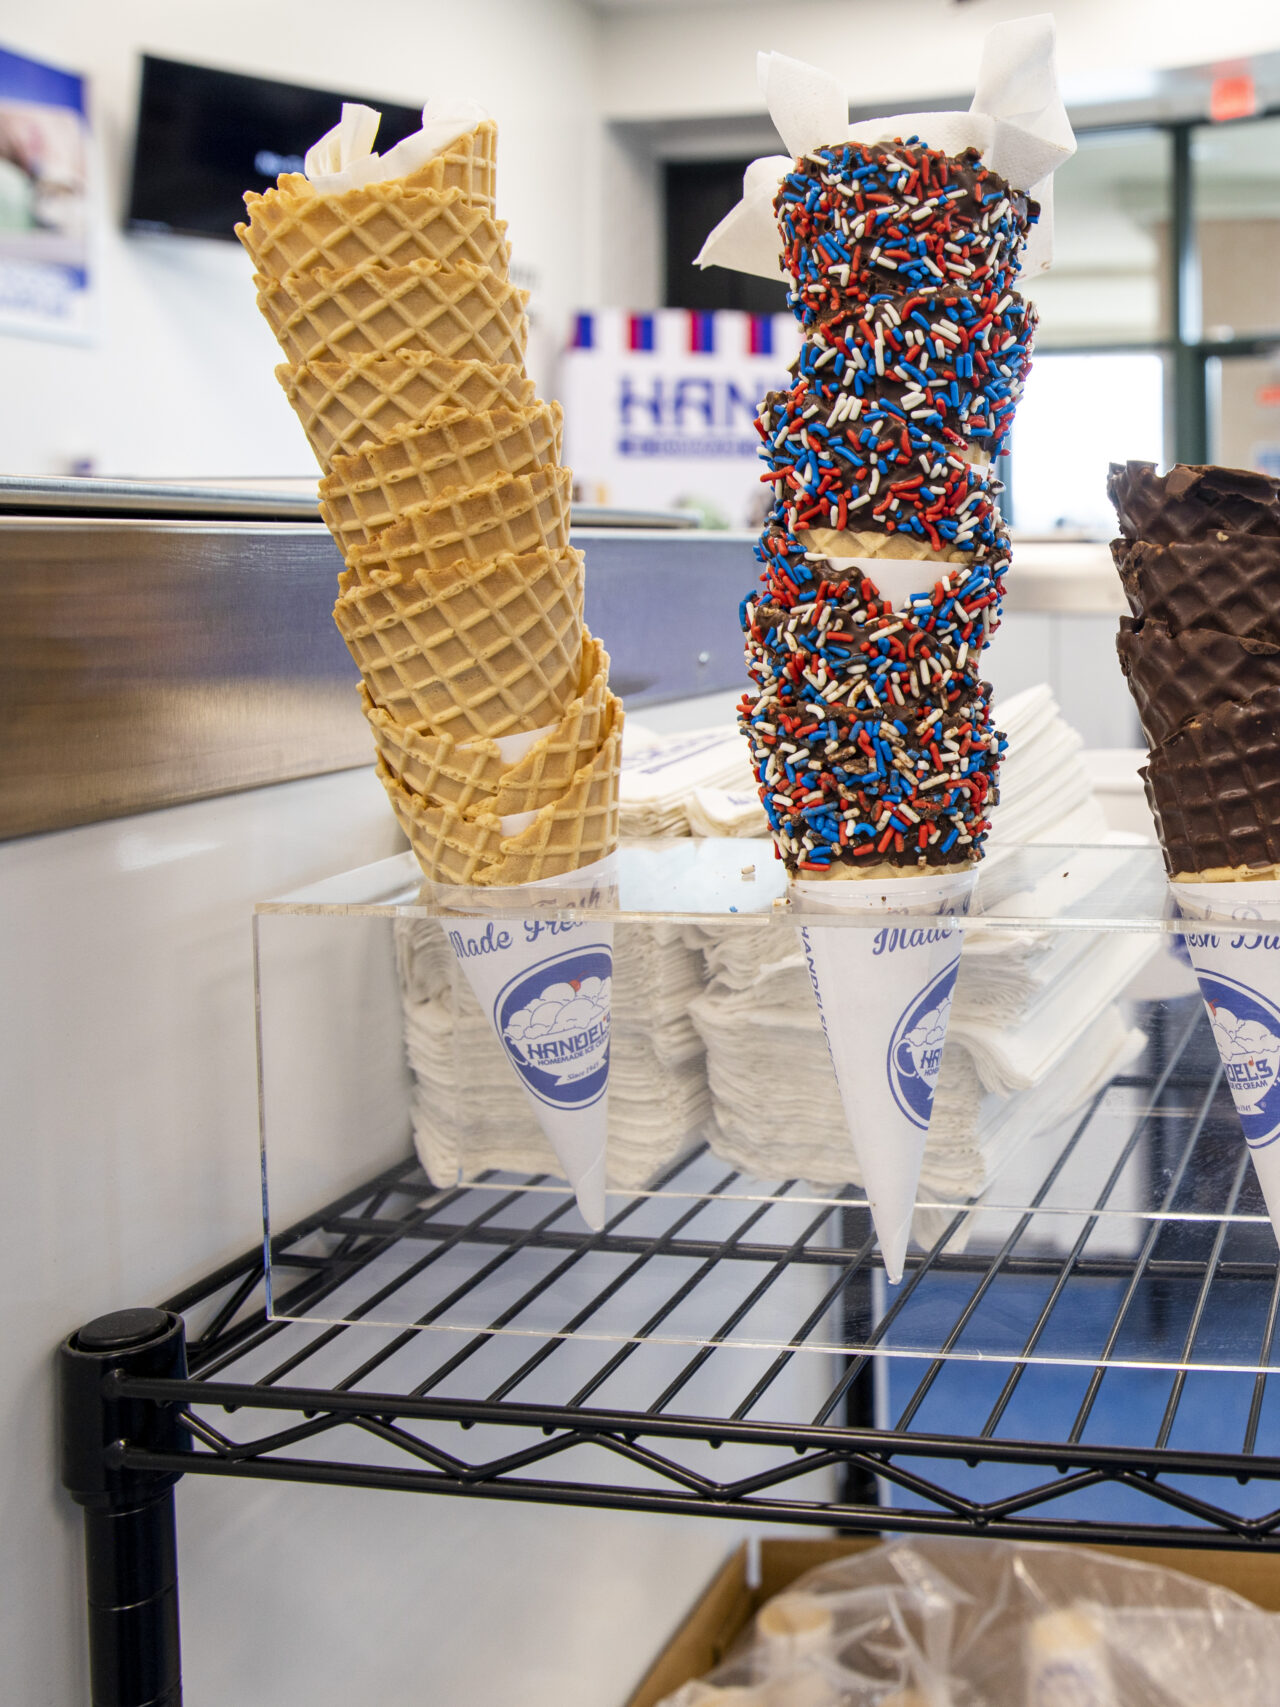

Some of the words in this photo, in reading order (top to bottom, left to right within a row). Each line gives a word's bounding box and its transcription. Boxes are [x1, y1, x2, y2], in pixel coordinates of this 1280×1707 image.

[619, 375, 792, 427] HAN
[449, 921, 513, 958] Made
[538, 1051, 584, 1066] HOMEMADE
[1243, 1079, 1268, 1090] CREAM
